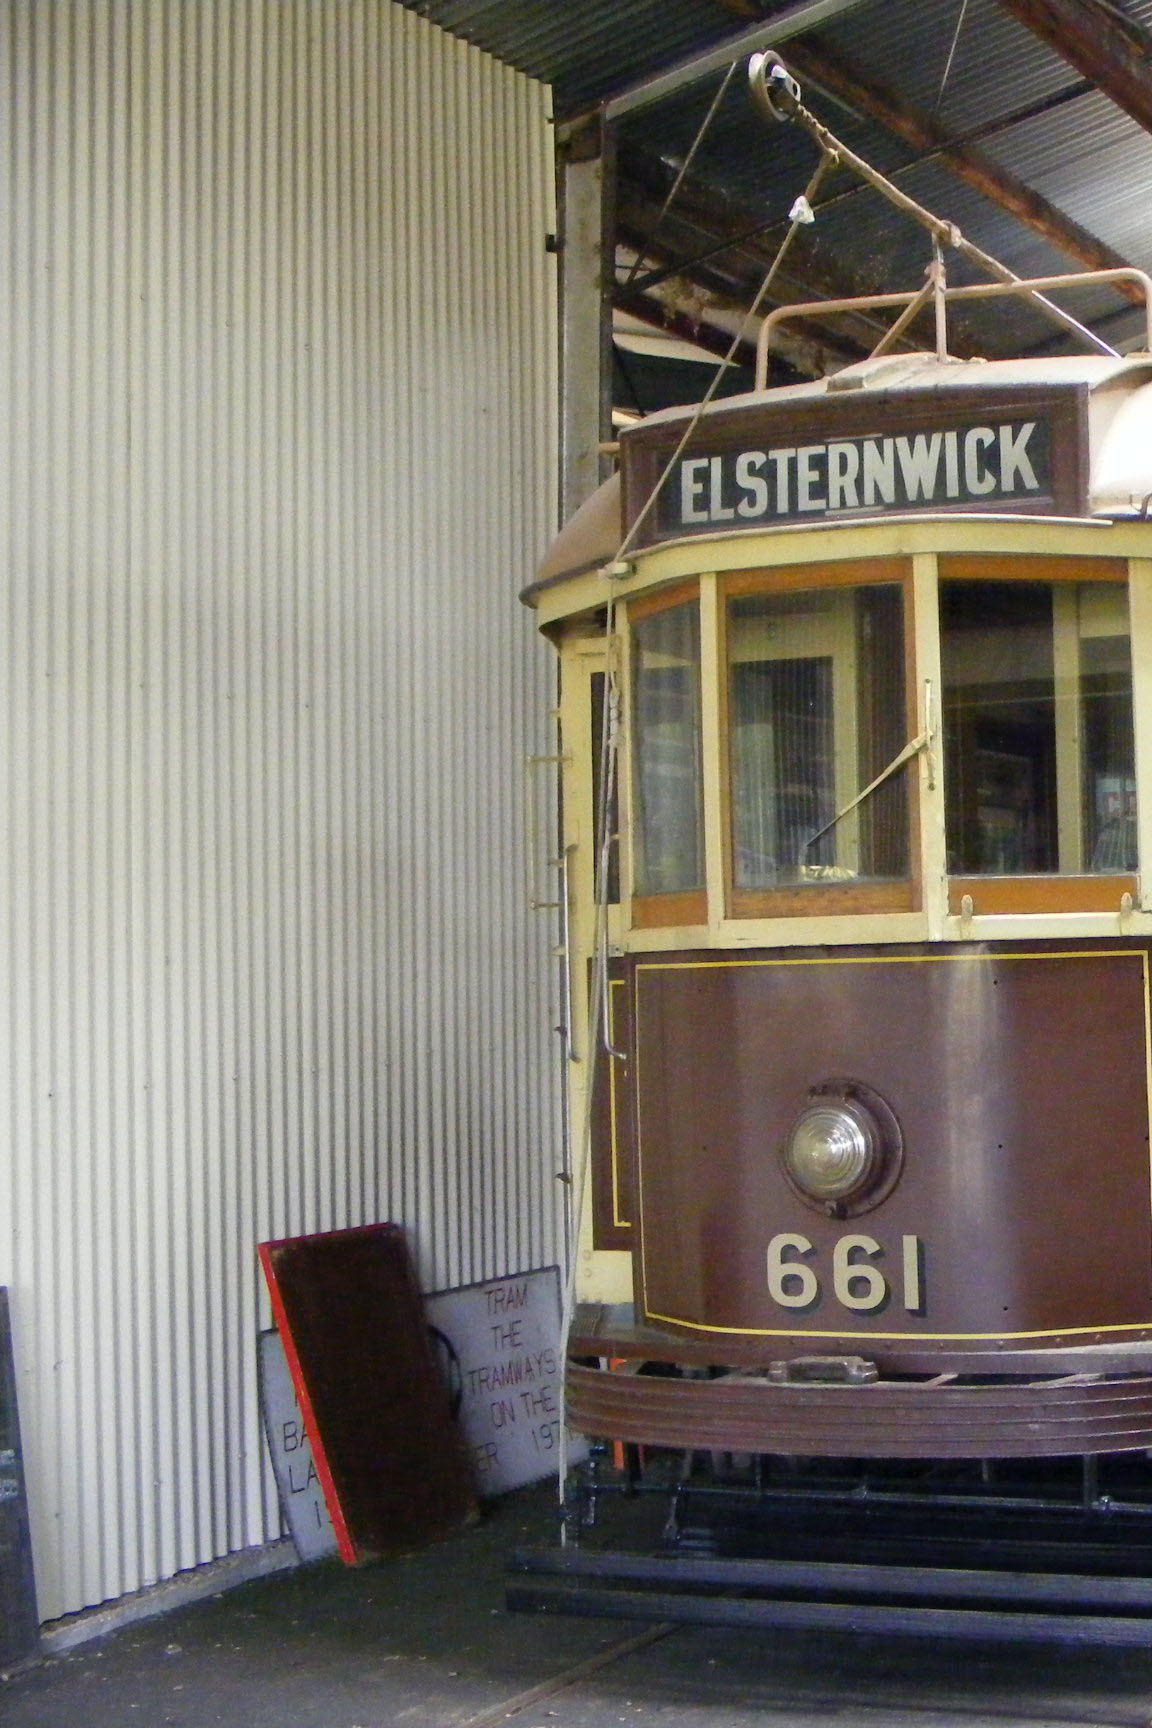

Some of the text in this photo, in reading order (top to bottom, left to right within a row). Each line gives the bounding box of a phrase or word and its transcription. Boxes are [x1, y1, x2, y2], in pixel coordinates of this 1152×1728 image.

[681, 422, 1039, 523] ELSTERNWICK
[767, 1233, 920, 1310] 661
[485, 1283, 528, 1314] TRAM
[490, 1319, 522, 1352] THE
[467, 1347, 557, 1396] TRAMWAYS
[490, 1384, 557, 1429] ON THE
